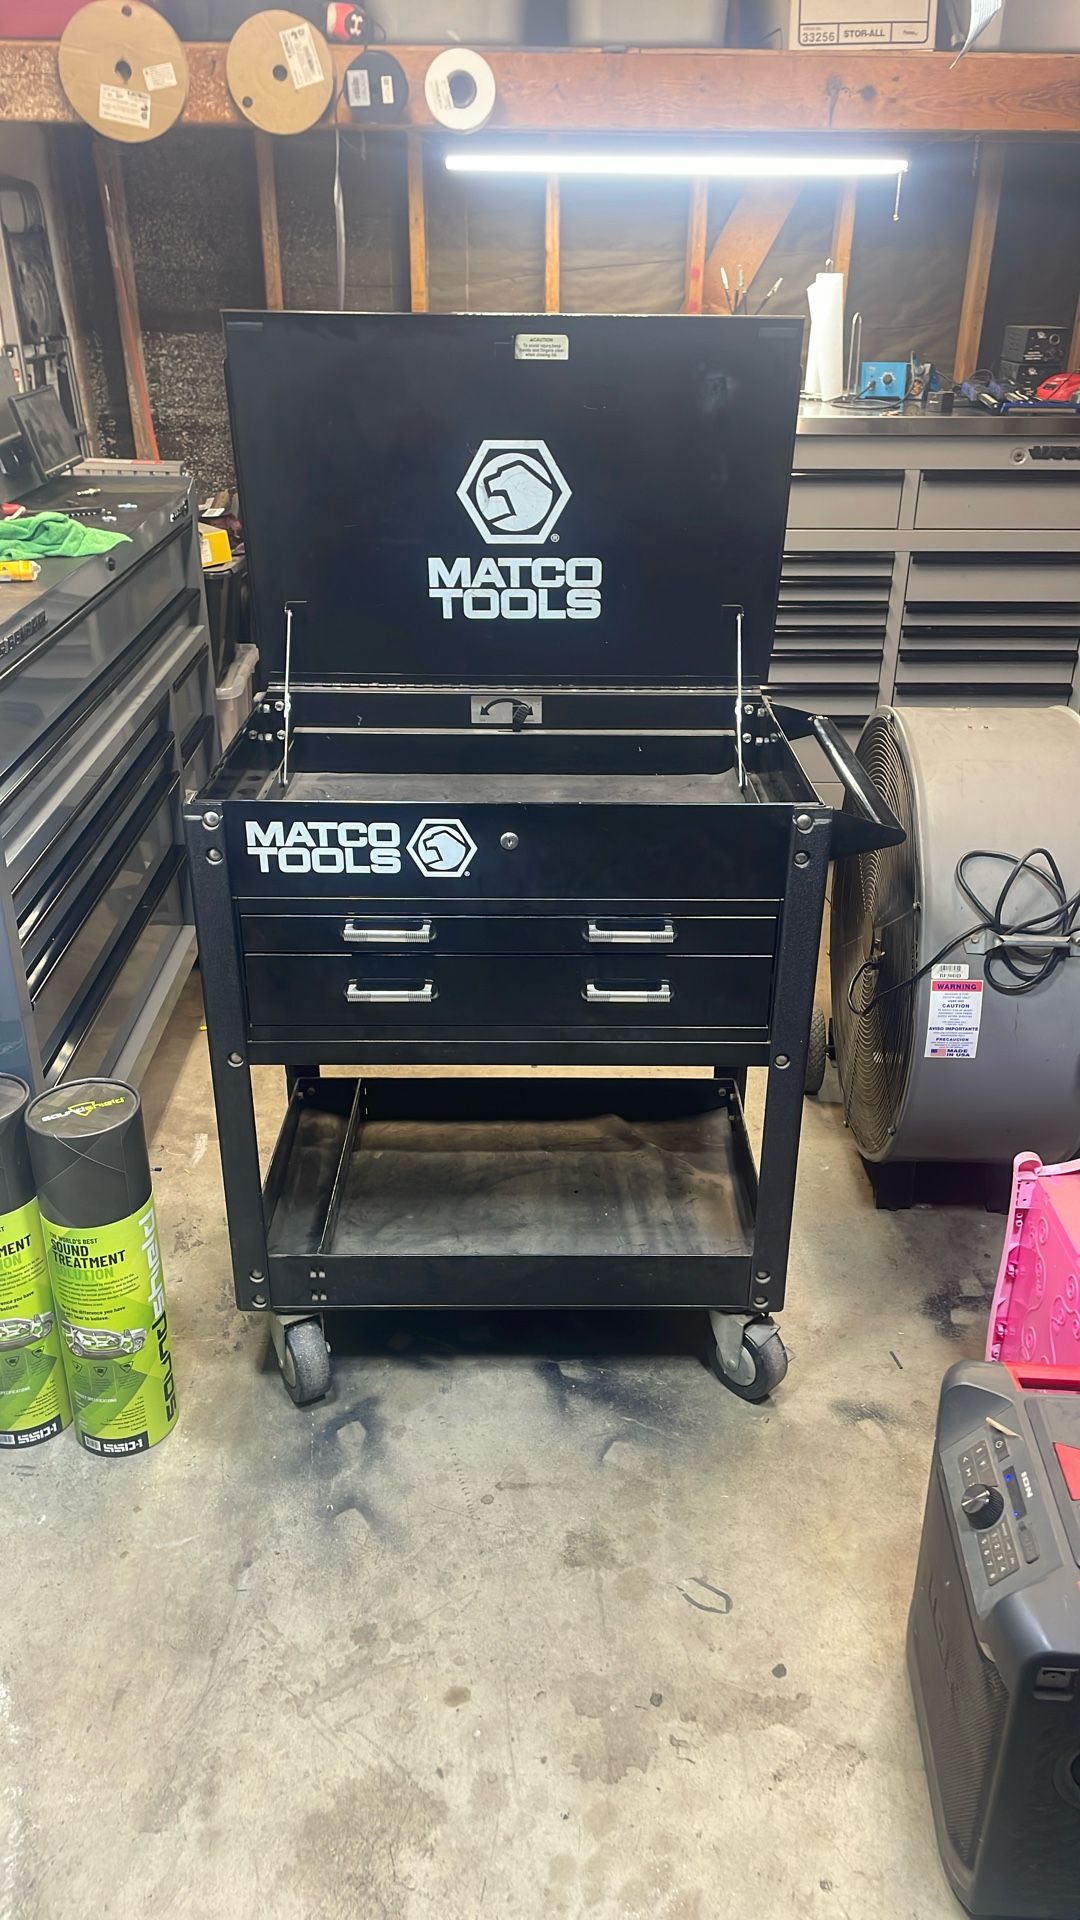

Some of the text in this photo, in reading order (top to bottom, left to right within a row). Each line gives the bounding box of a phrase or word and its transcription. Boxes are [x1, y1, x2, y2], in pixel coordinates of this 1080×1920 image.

[802, 29, 885, 43] 33256 STOR-ALL
[427, 557, 603, 588] MATCO
[428, 588, 602, 619] TOOLS
[245, 821, 401, 848] MATCO
[247, 847, 402, 874] TOOLS
[51, 1238, 89, 1257] SOUND
[53, 1250, 126, 1269] TREATMENT
[18, 1423, 57, 1444] SSD-1
[103, 1439, 143, 1453] SSD-1
[1021, 1471, 1034, 1499] ION
